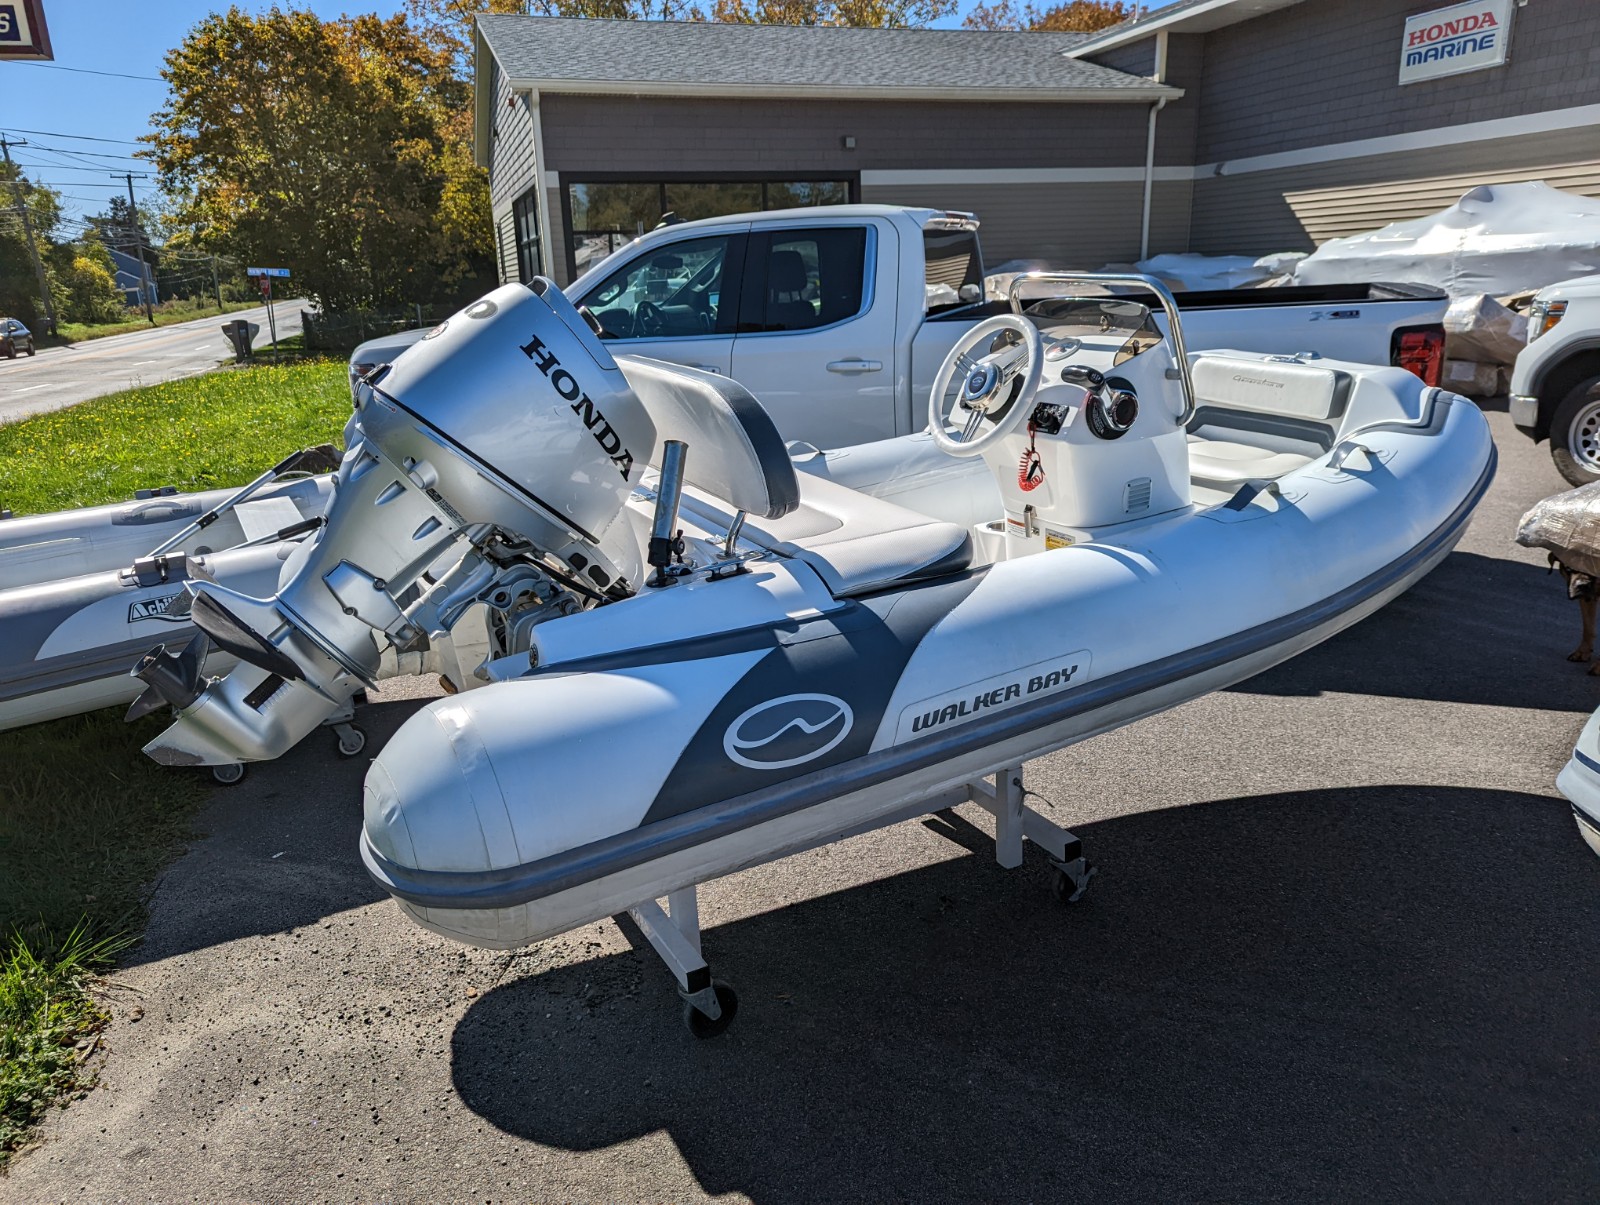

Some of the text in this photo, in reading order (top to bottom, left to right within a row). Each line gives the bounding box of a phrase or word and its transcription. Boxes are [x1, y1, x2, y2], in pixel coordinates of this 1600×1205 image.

[1407, 11, 1498, 47] HONDA
[519, 334, 634, 482] HONDA
[911, 664, 1078, 733] WALKER BAY
